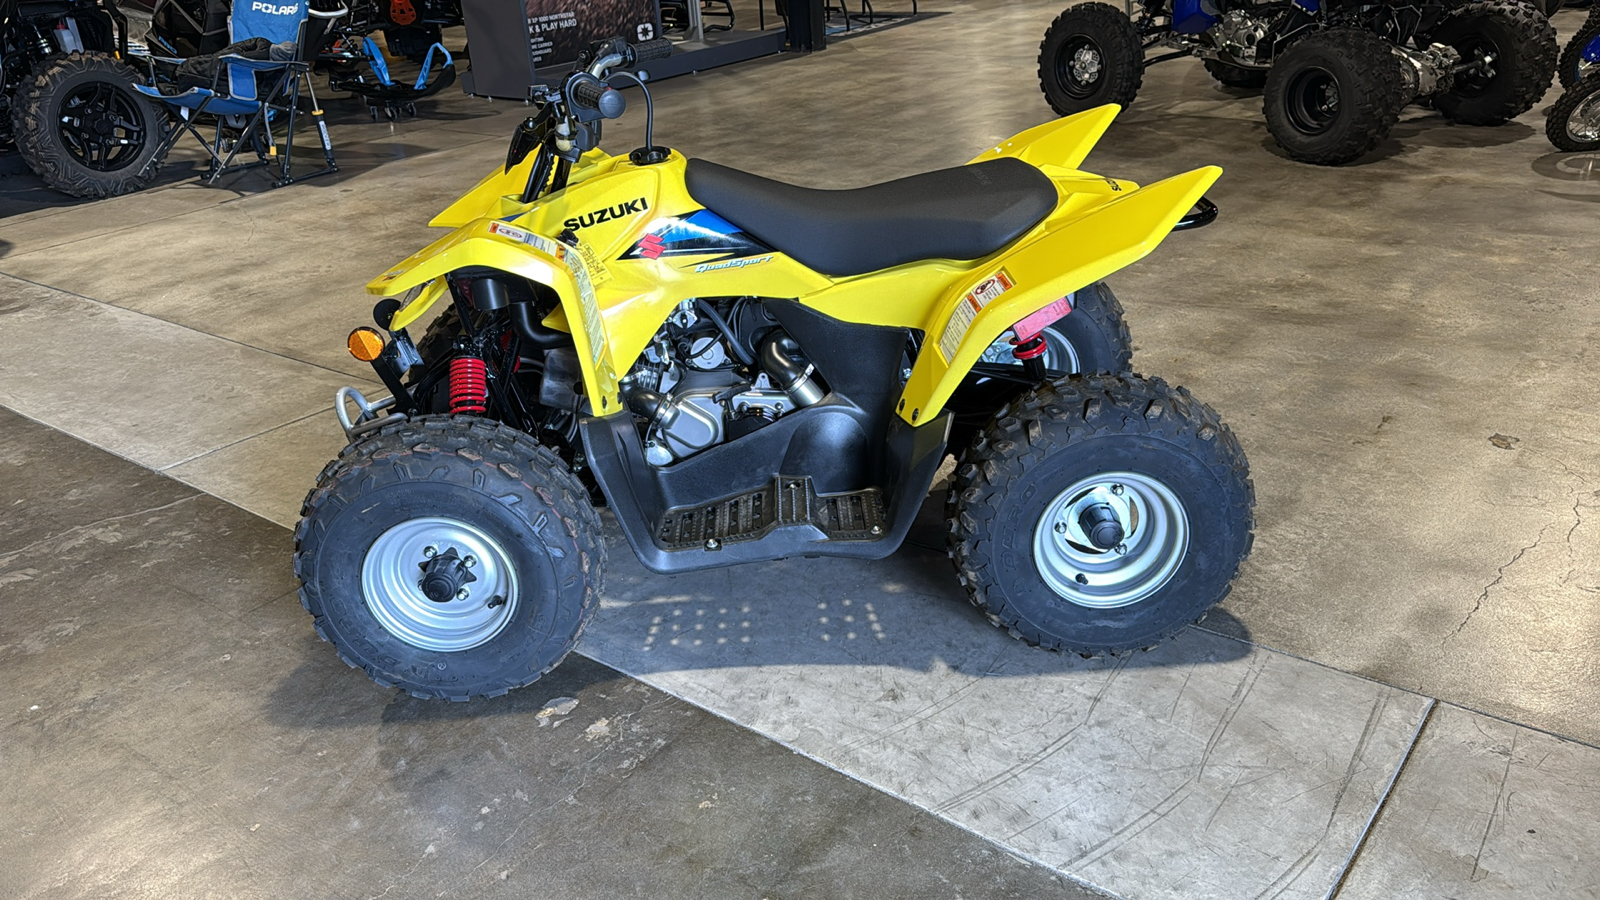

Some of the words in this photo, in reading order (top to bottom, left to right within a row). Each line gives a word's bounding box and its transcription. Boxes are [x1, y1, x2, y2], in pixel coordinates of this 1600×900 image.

[549, 11, 575, 19] NORTHSTAR
[535, 24, 540, 33] &
[541, 21, 558, 31] PLAY
[559, 18, 577, 28] HARD
[564, 197, 648, 232] SUZUKI
[695, 255, 774, 273] QuadSport
[1001, 483, 1037, 569] DURO
